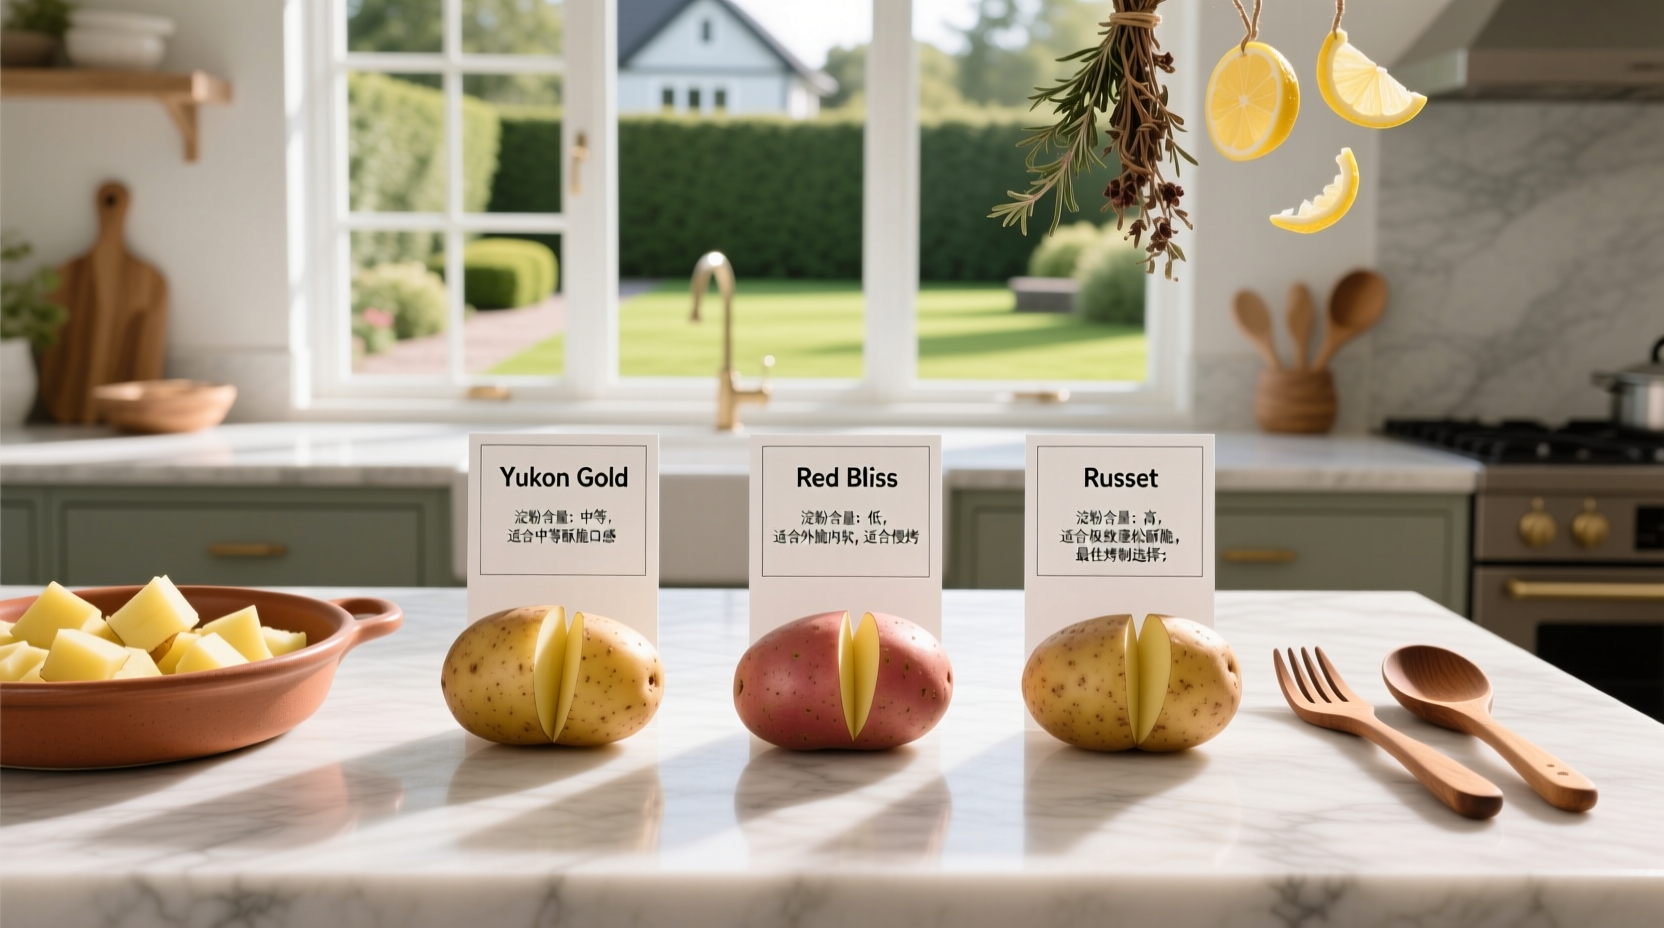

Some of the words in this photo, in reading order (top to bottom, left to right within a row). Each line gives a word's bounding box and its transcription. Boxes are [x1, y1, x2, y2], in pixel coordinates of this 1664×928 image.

[499, 465, 569, 488] Yukon
[576, 465, 629, 488] Gold
[797, 466, 839, 488] Red
[847, 466, 898, 488] Bliss
[1084, 467, 1159, 488] Russet
